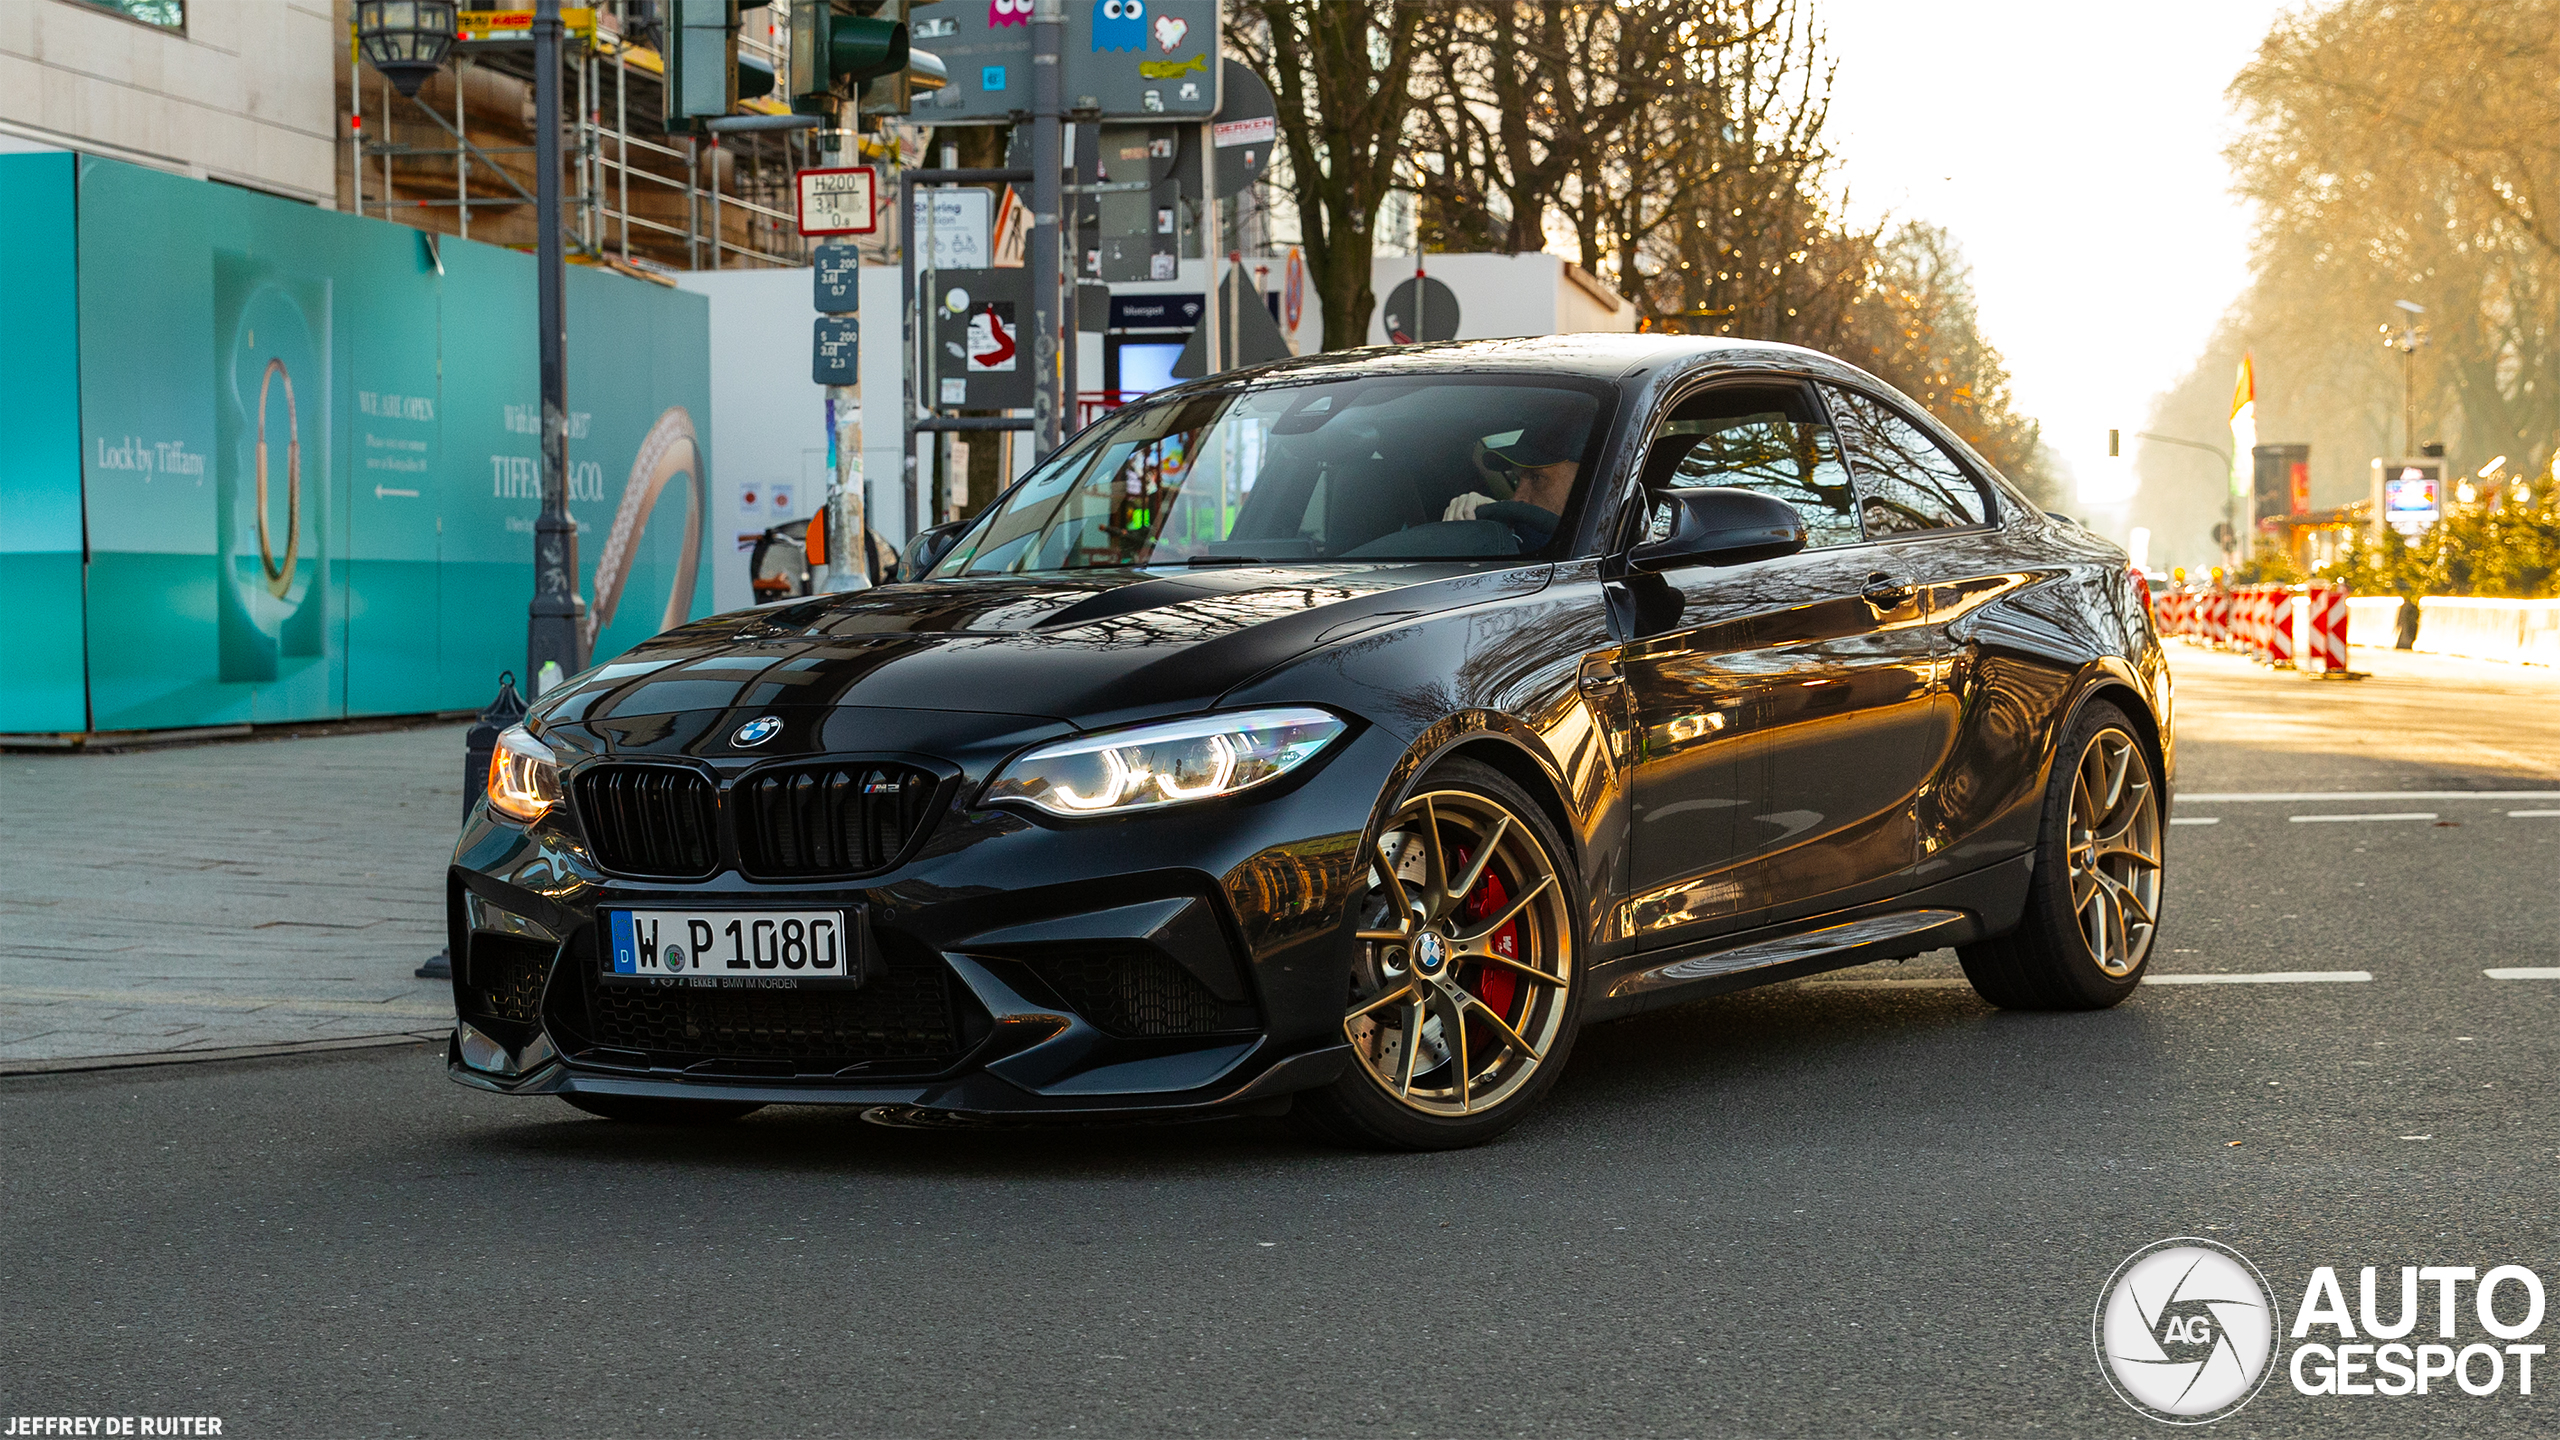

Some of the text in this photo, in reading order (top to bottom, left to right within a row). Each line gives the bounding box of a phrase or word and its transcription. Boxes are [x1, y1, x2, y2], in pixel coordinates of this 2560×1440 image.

[839, 258, 858, 270] 200
[839, 331, 858, 343] 200
[98, 436, 206, 487] Lock by Tiffany
[490, 455, 542, 499] TIFFA
[635, 918, 659, 968] W
[620, 949, 629, 964] D
[722, 978, 744, 989] BMW
[758, 979, 798, 990] NORDEN
